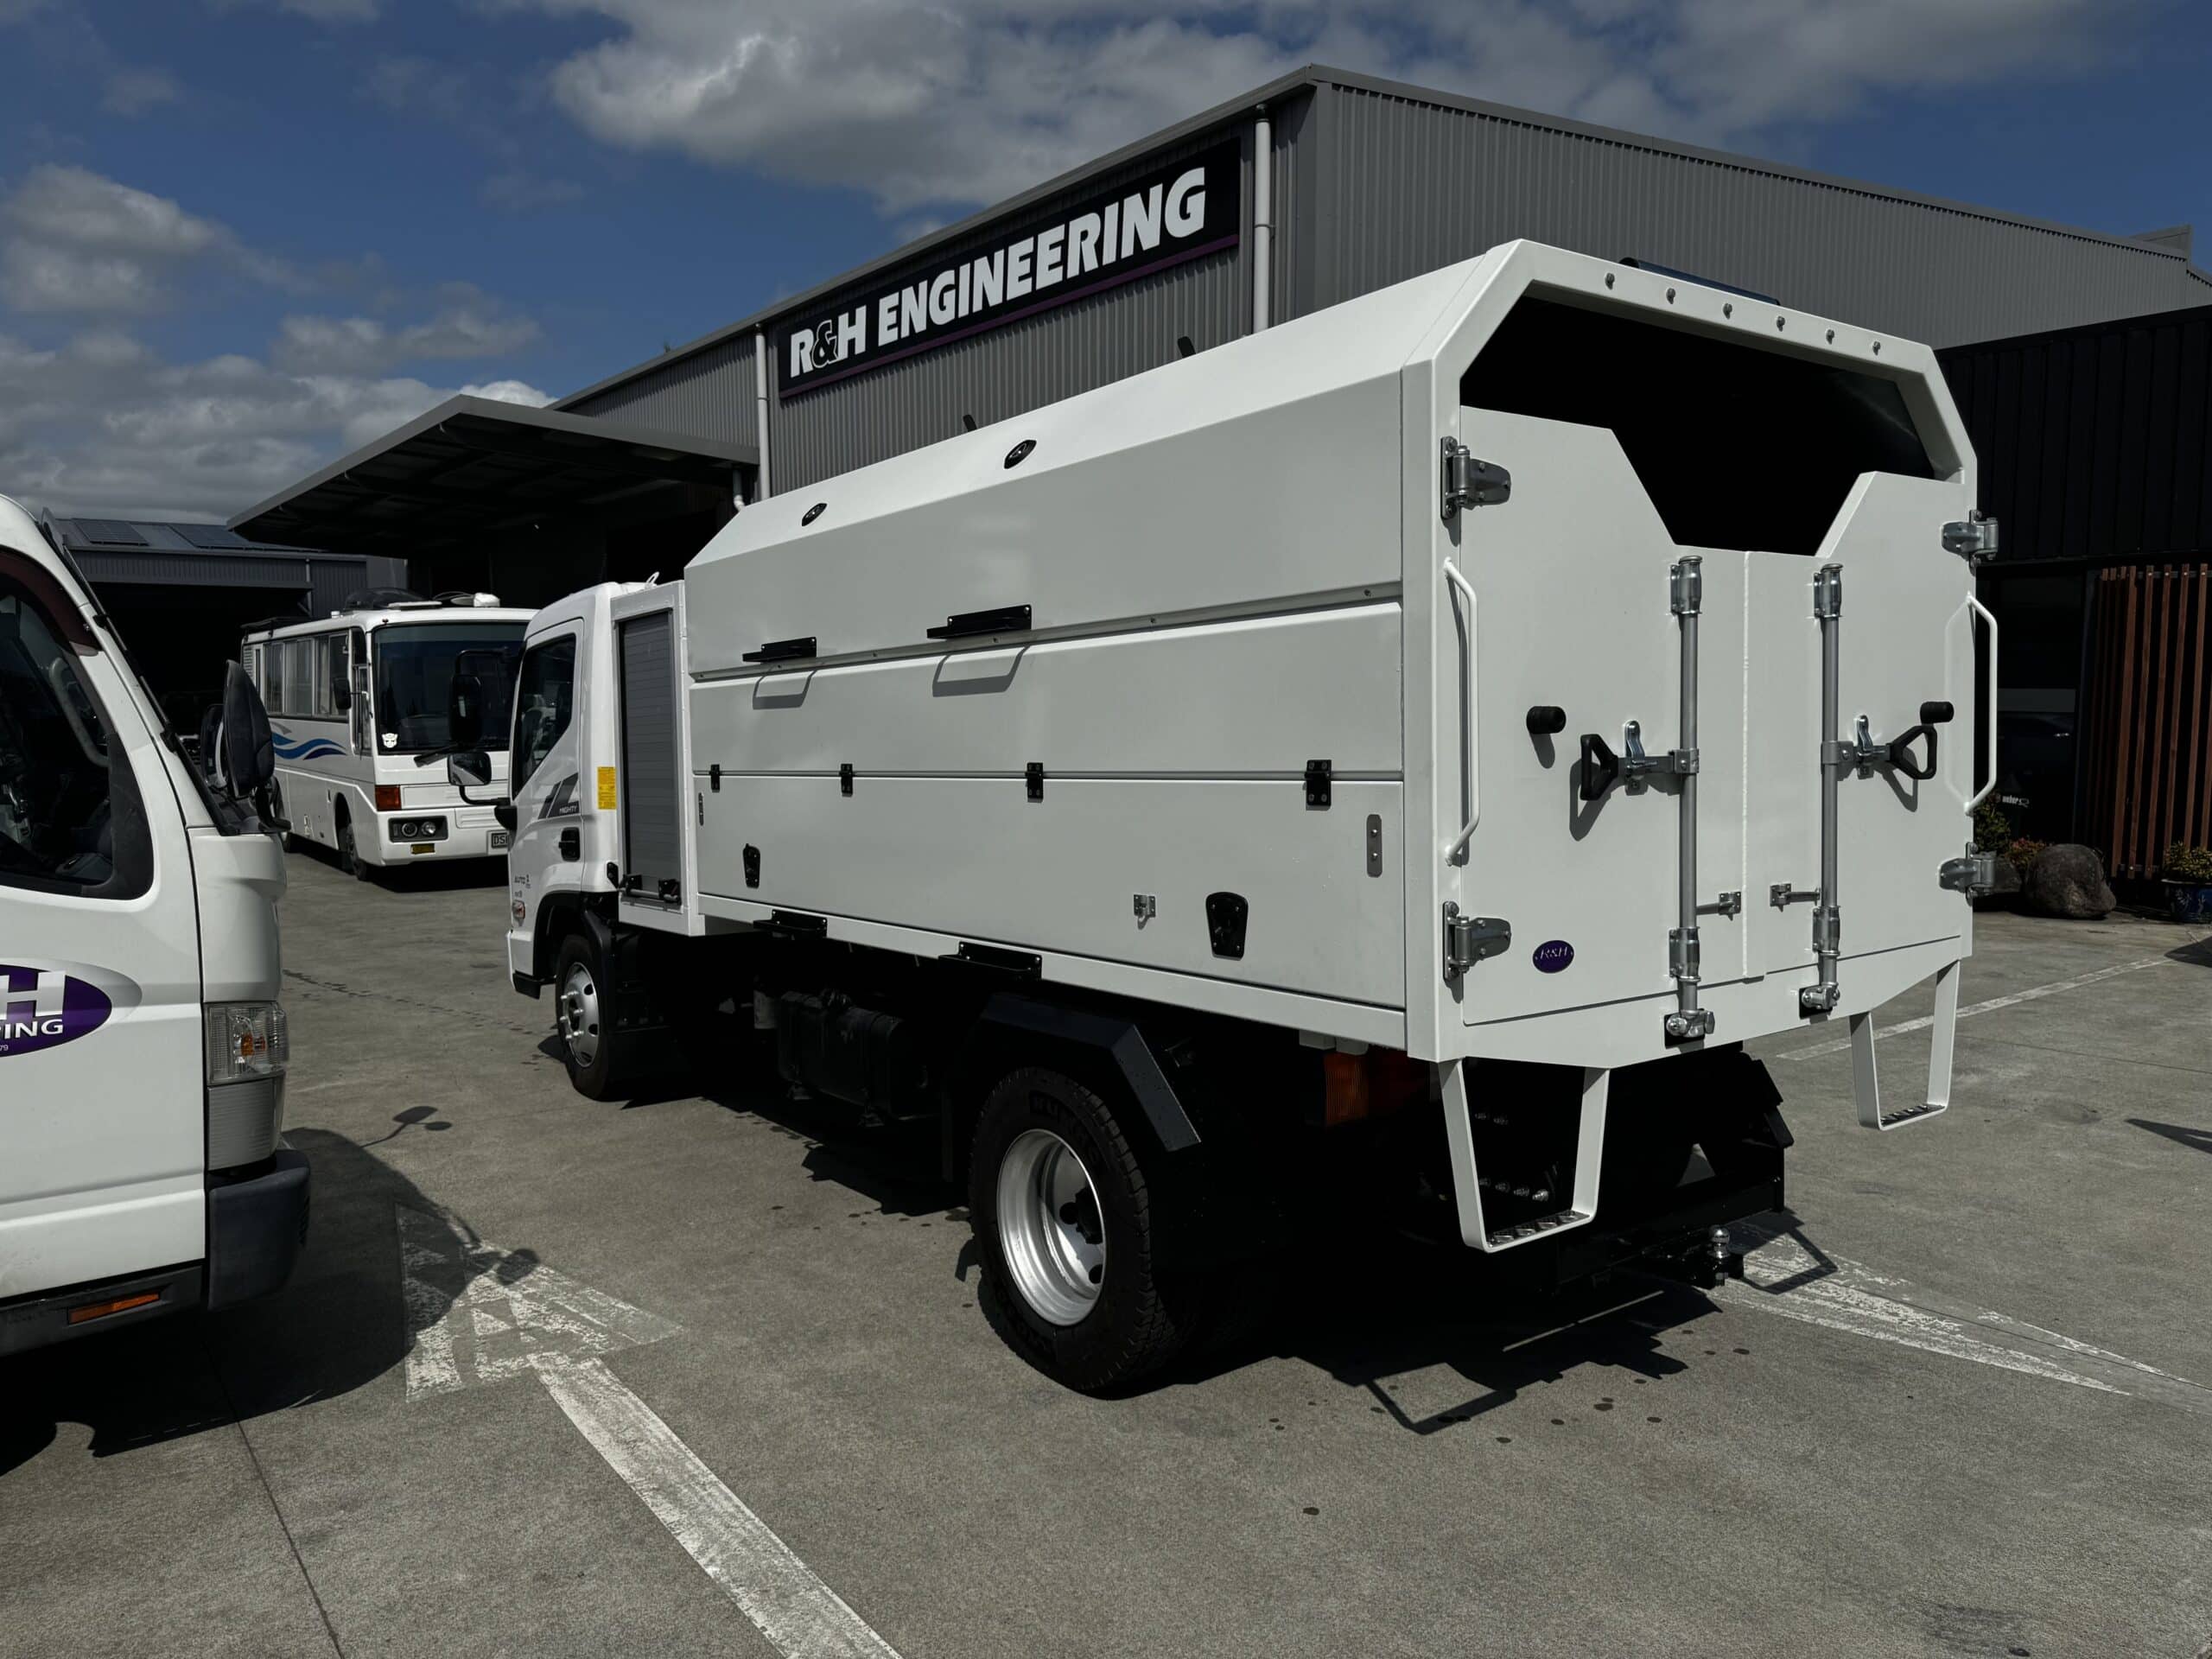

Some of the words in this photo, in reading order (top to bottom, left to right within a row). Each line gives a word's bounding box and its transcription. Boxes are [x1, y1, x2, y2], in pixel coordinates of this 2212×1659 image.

[790, 305, 866, 378] R&H
[877, 167, 1206, 347] ENGINEERING
[1540, 946, 1568, 960] R&H
[0, 1019, 63, 1039] ING
